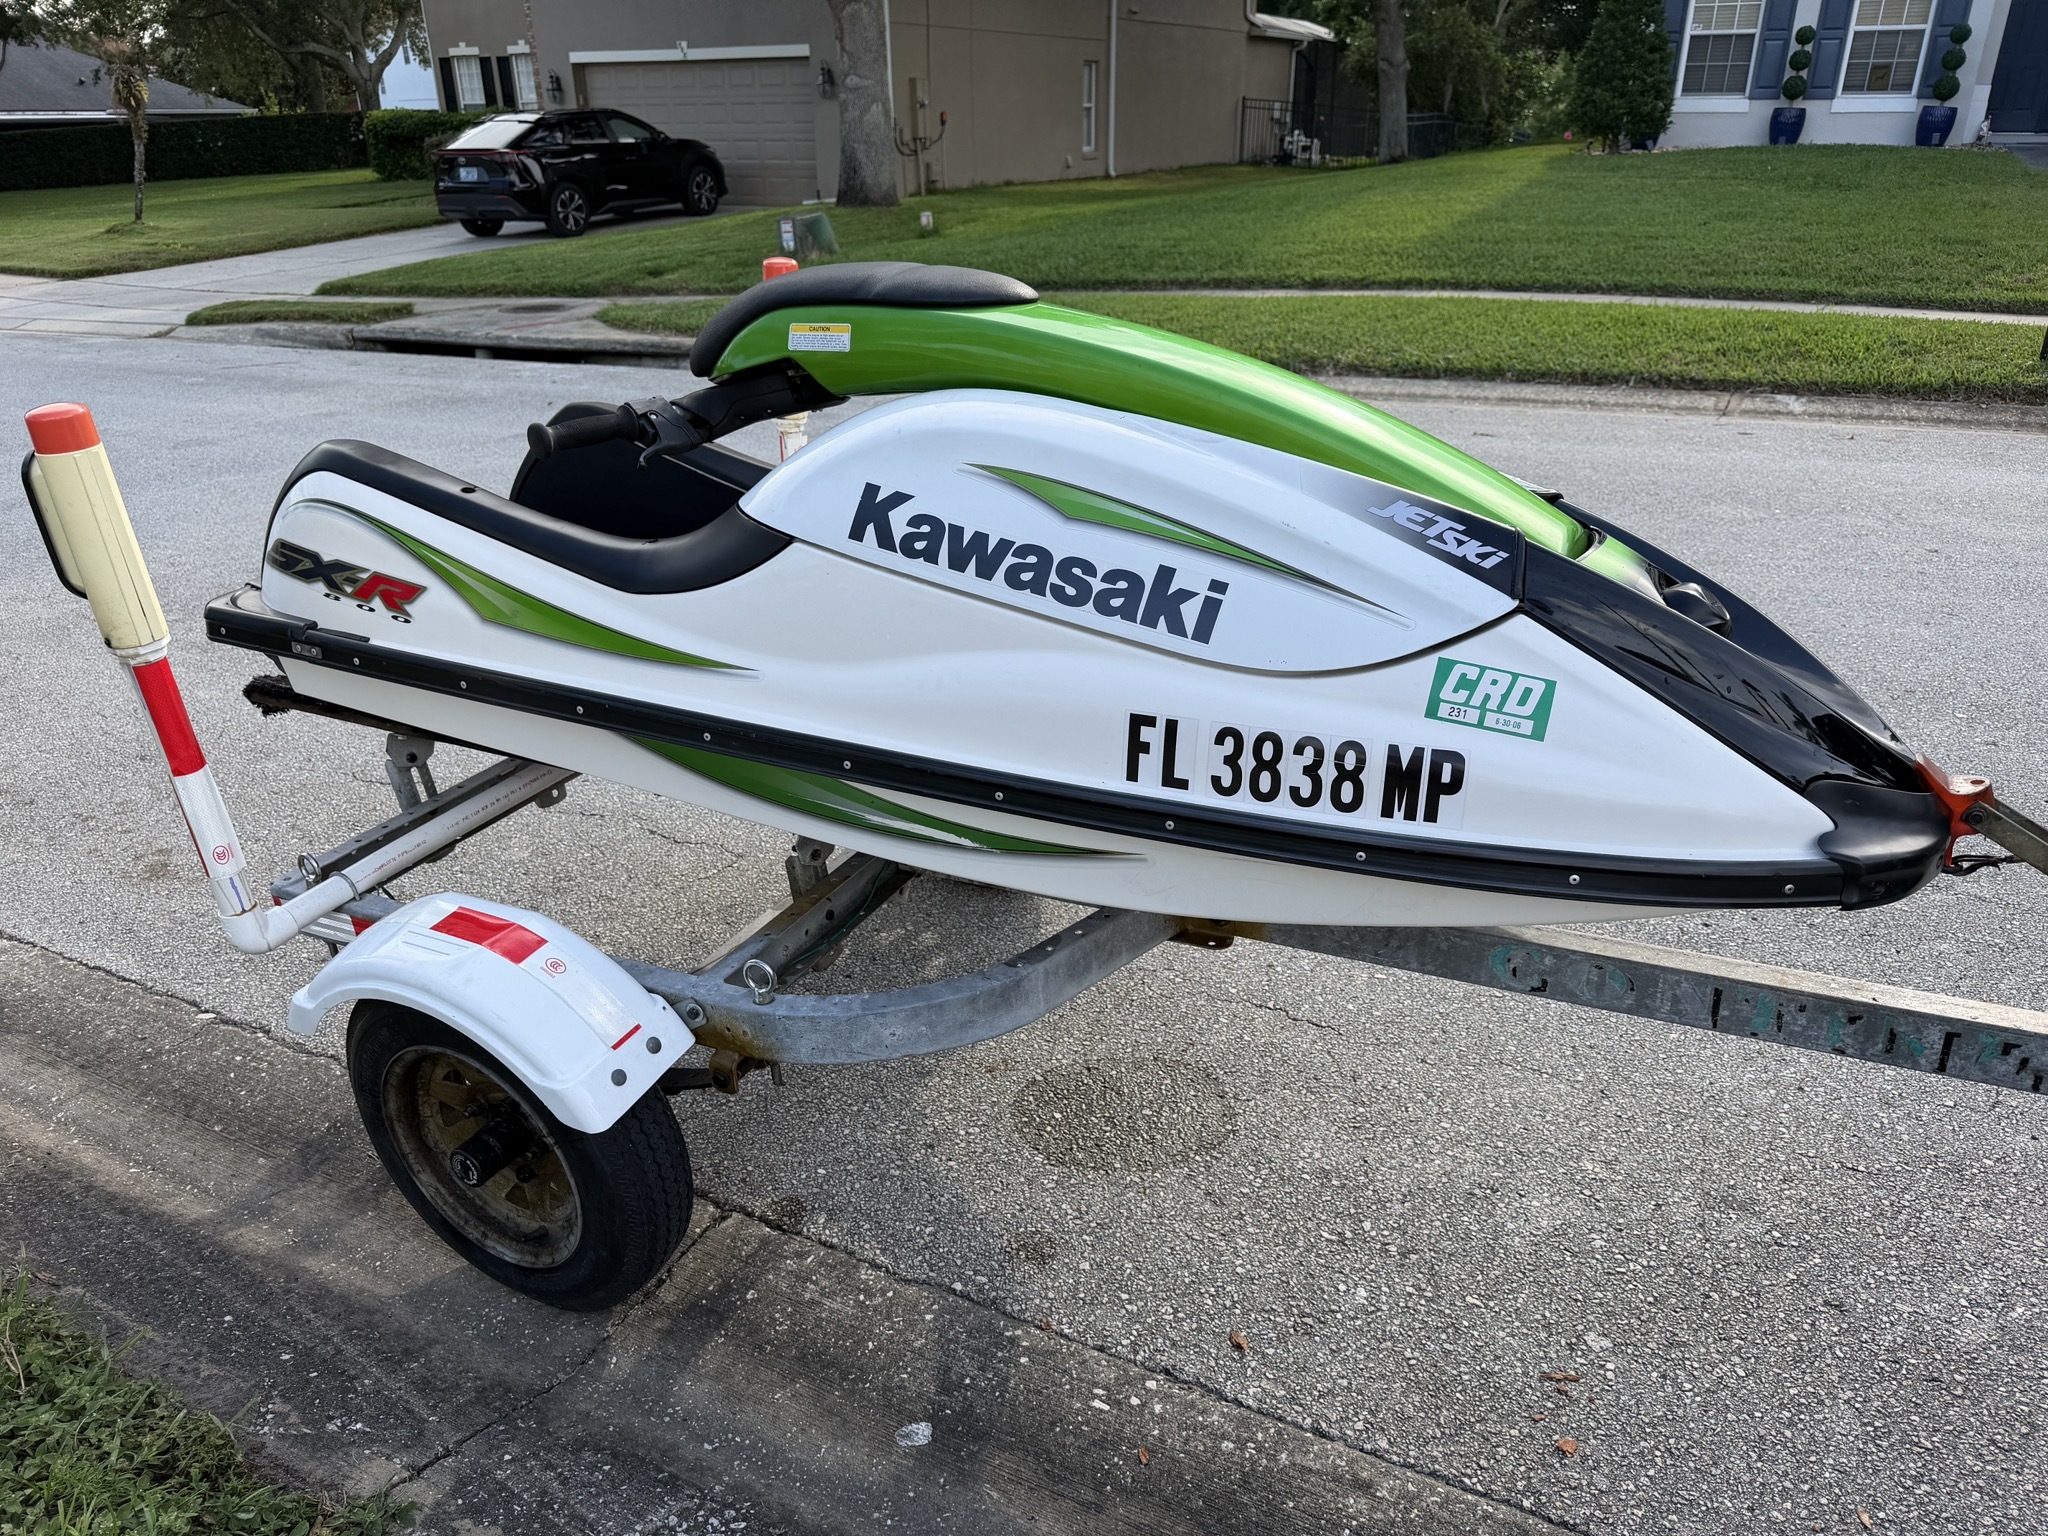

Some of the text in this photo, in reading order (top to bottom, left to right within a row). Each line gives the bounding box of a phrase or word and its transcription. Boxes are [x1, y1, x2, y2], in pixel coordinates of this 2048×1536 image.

[847, 482, 1230, 645] Kawasaki
[1439, 663, 1546, 716] CRD
[1448, 706, 1468, 719] 231
[1126, 713, 1466, 824] FL 3838 MP
